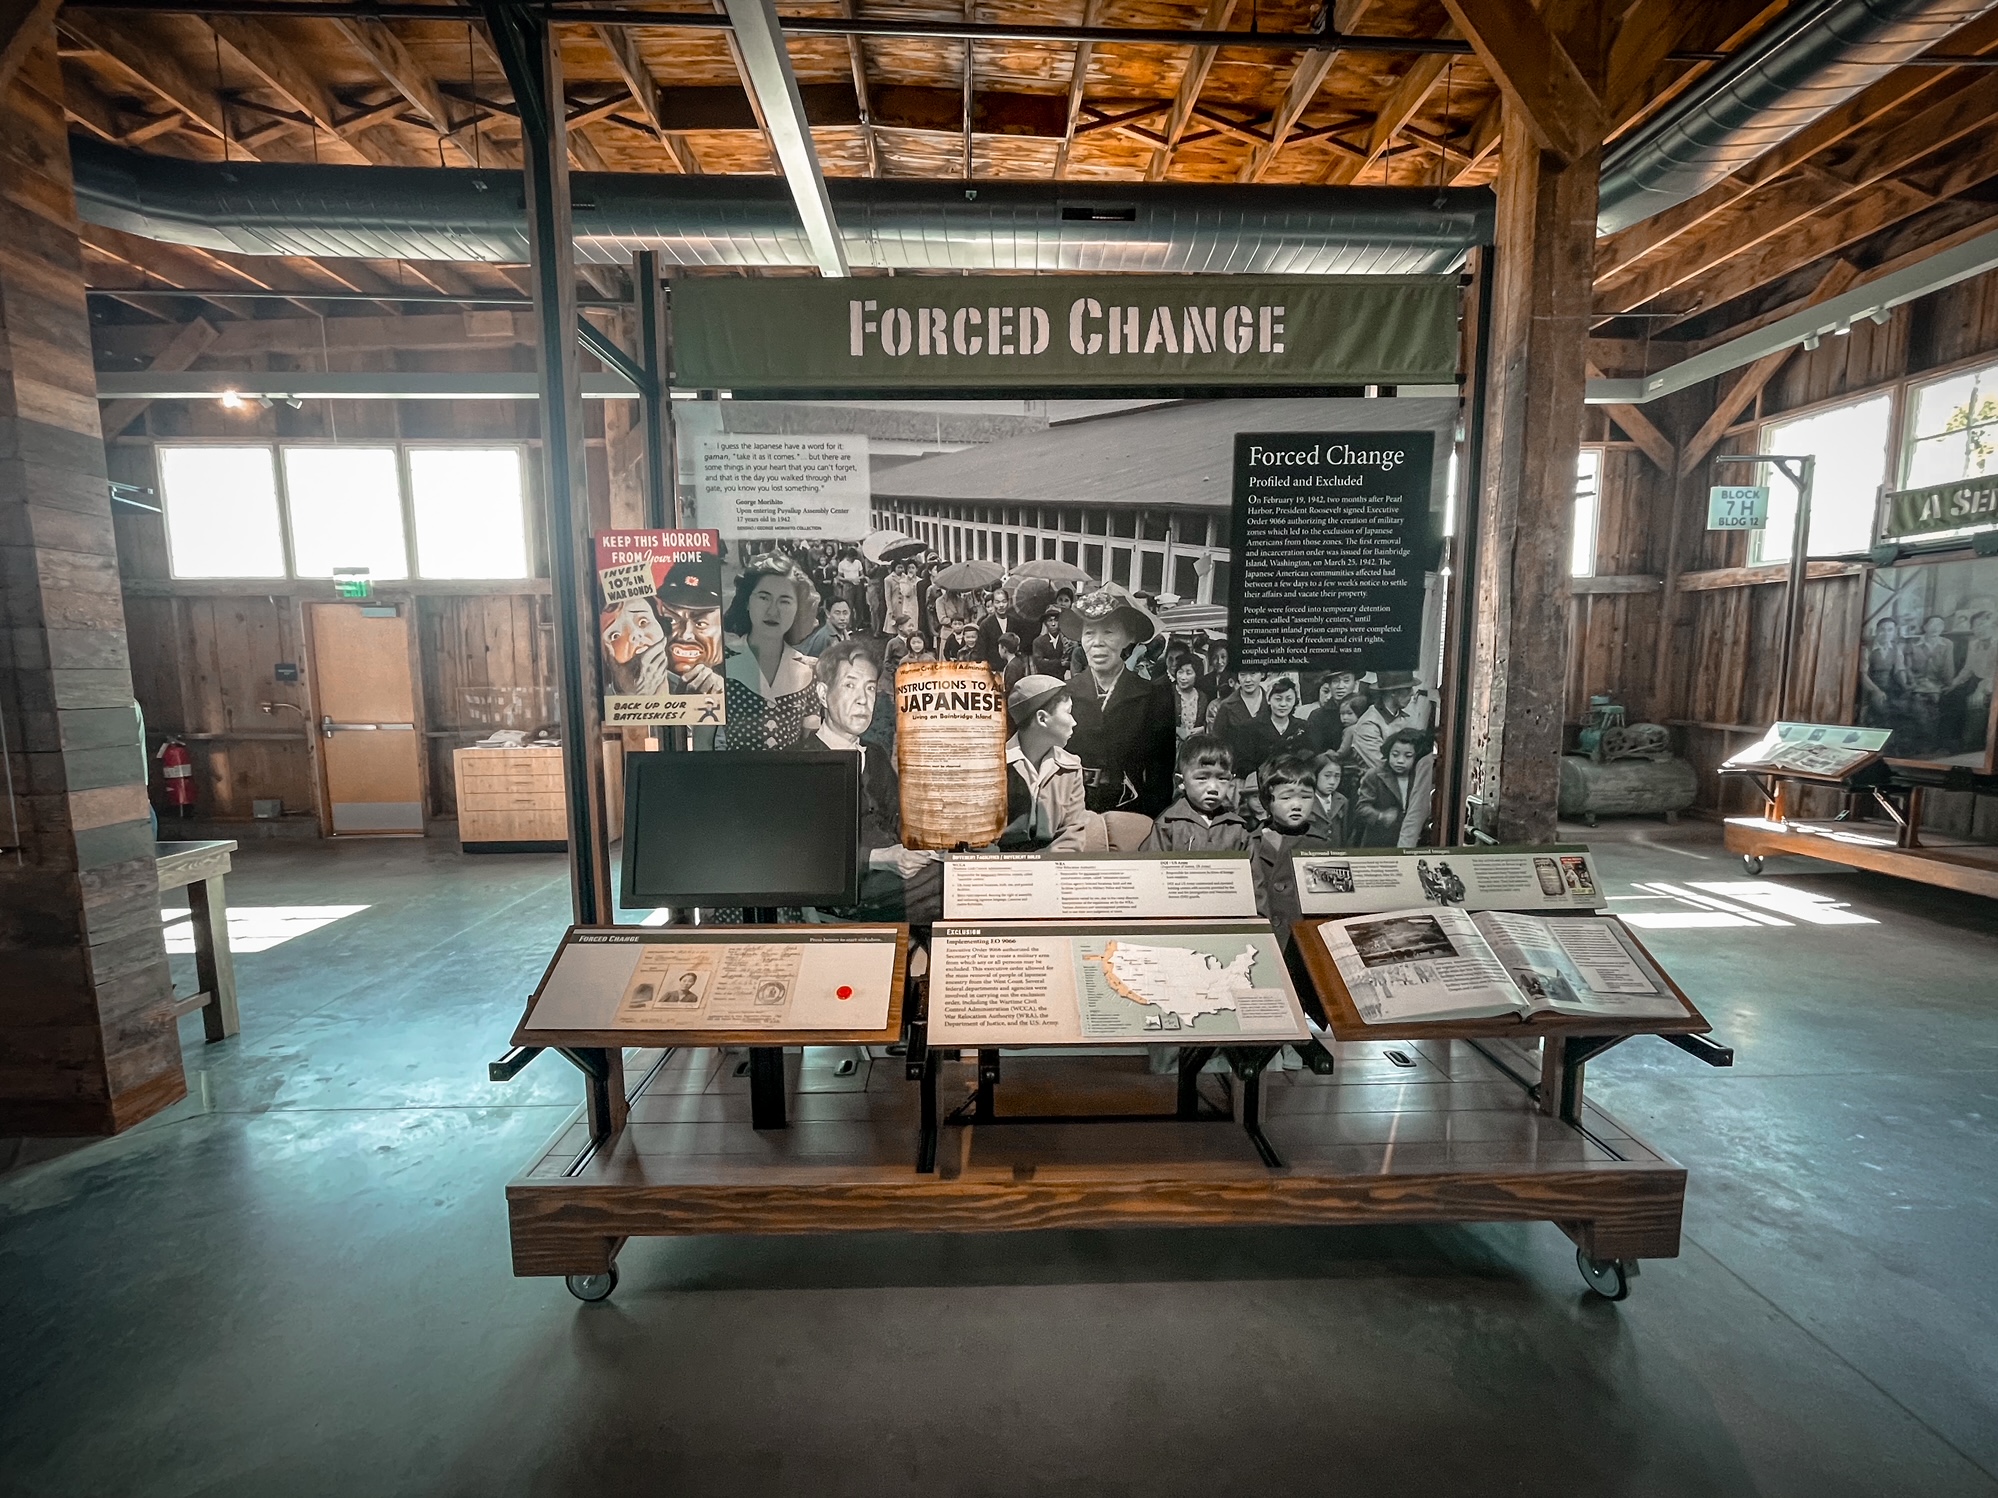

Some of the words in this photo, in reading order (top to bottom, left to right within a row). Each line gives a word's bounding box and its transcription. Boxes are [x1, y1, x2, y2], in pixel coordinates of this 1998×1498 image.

[850, 300, 1050, 356] FORCED
[1069, 298, 1285, 355] CHANGE
[754, 443, 782, 451] Japanese
[1248, 445, 1320, 466] Forced
[1326, 445, 1404, 470] Change
[724, 464, 744, 473] things
[835, 464, 856, 473] forget,
[754, 474, 765, 483] day
[806, 474, 832, 483] through
[1250, 476, 1290, 487] Profiled
[1293, 476, 1312, 487] and
[1316, 475, 1363, 486] Excluded
[705, 485, 722, 494] gate,
[785, 485, 824, 494] something."
[1722, 490, 1760, 499] BLOCK
[1248, 495, 1261, 504] On
[1263, 496, 1293, 506] February
[1296, 496, 1305, 505] 19,
[1308, 496, 1325, 505] 1942,
[1248, 507, 1274, 516] Harbor,
[1343, 506, 1365, 516] signed
[1727, 501, 1735, 515] 7
[1741, 501, 1754, 515] H
[1919, 495, 1941, 520] A
[1287, 517, 1326, 527] authorizing
[1377, 516, 1404, 526] military
[1719, 517, 1746, 526] BLDG
[1364, 527, 1393, 536] Japanese
[603, 536, 631, 547] KEEP
[634, 536, 658, 547] THIS
[662, 533, 710, 547] HORROR
[612, 552, 642, 563] FROM
[673, 552, 702, 562] HOME
[604, 564, 645, 578] INVEST
[609, 576, 632, 589] 10%
[634, 575, 644, 584] IN
[608, 589, 627, 601] WAR
[628, 585, 653, 597] BONDS
[898, 681, 966, 693] NSTRUCTIONS
[971, 681, 986, 690] TO
[901, 692, 1002, 712] JAPANESE
